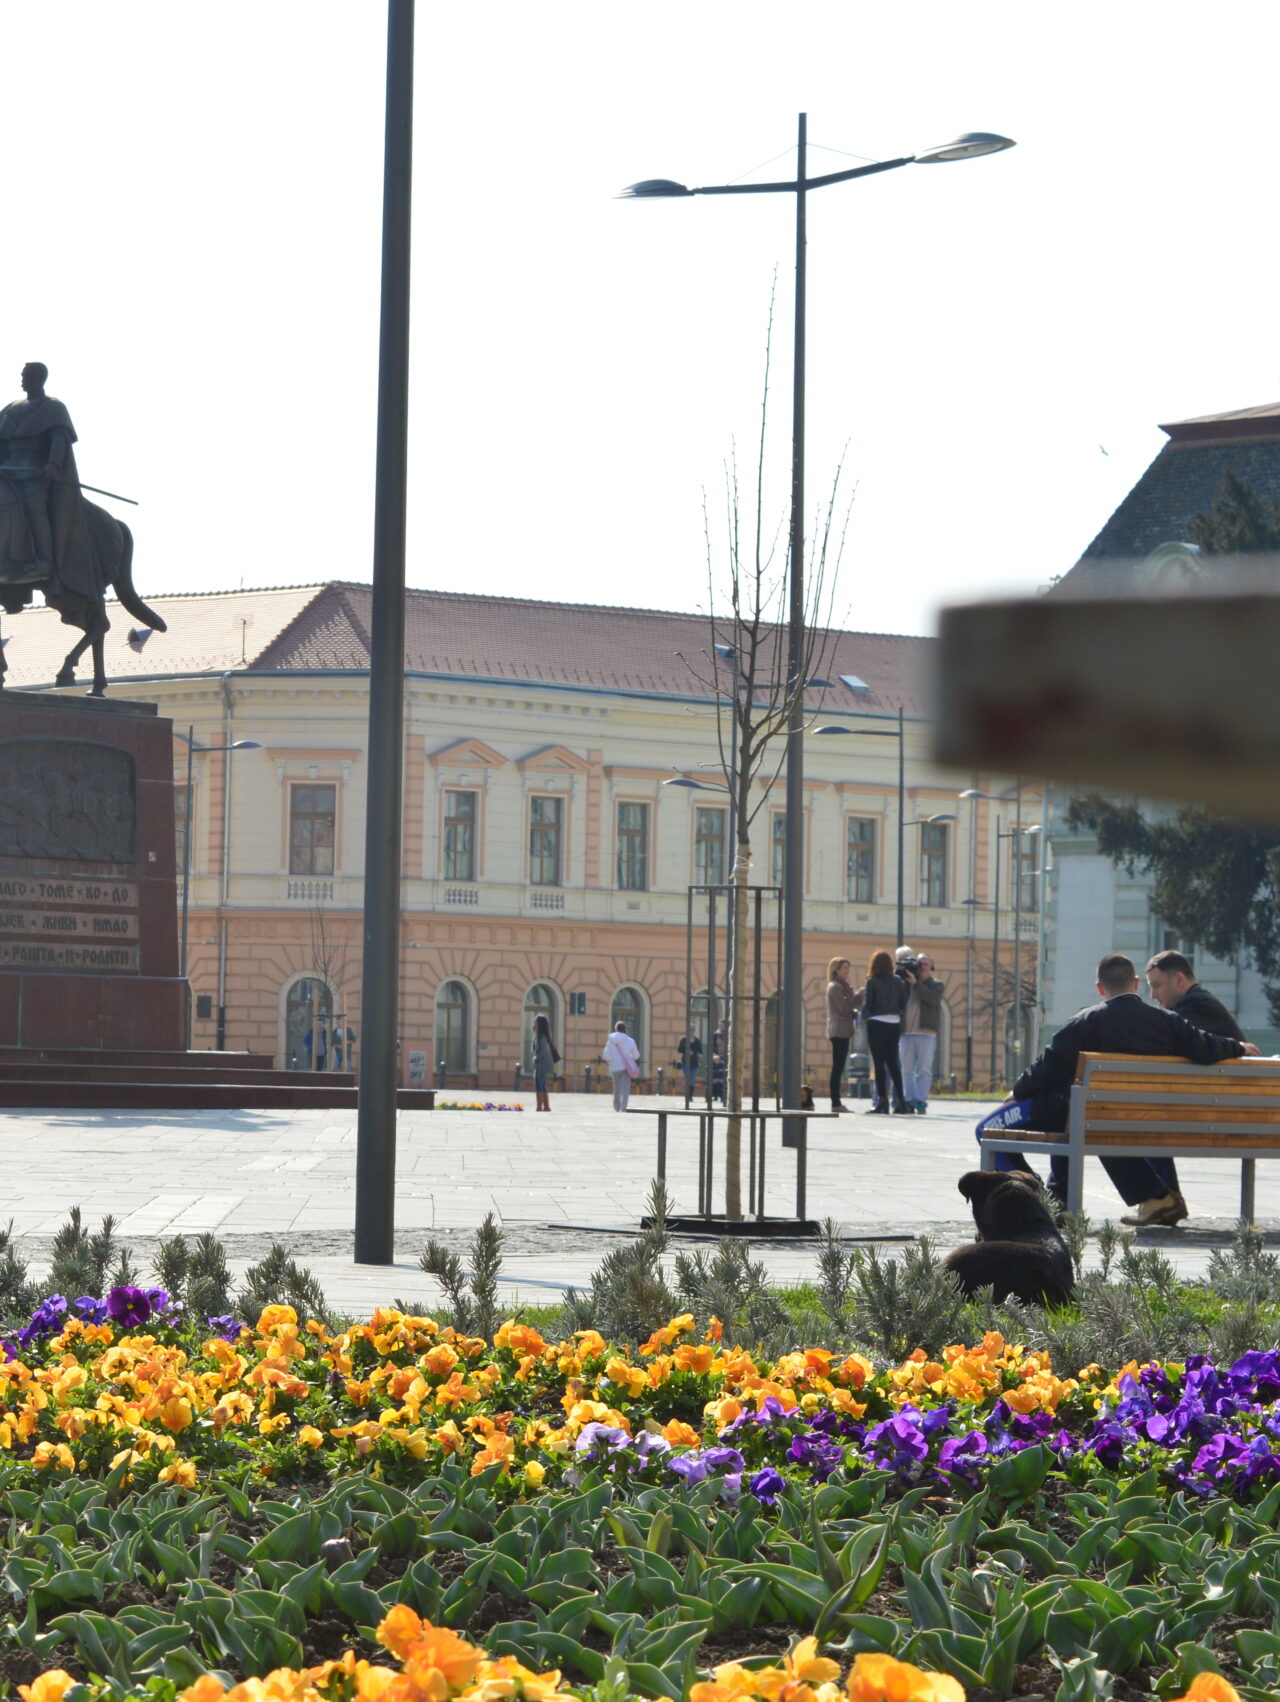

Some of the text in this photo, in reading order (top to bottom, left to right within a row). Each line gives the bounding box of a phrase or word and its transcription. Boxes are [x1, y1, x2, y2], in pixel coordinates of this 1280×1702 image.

[39, 883, 74, 898] ТОМЕ
[86, 886, 100, 900] КО
[112, 888, 128, 903] ДО
[42, 916, 76, 930] ЖИВИ
[93, 918, 128, 933] ИМАО
[12, 946, 55, 962] РАШТА
[82, 950, 128, 966] РОДИТИ
[1004, 1106, 1023, 1126] AIR
